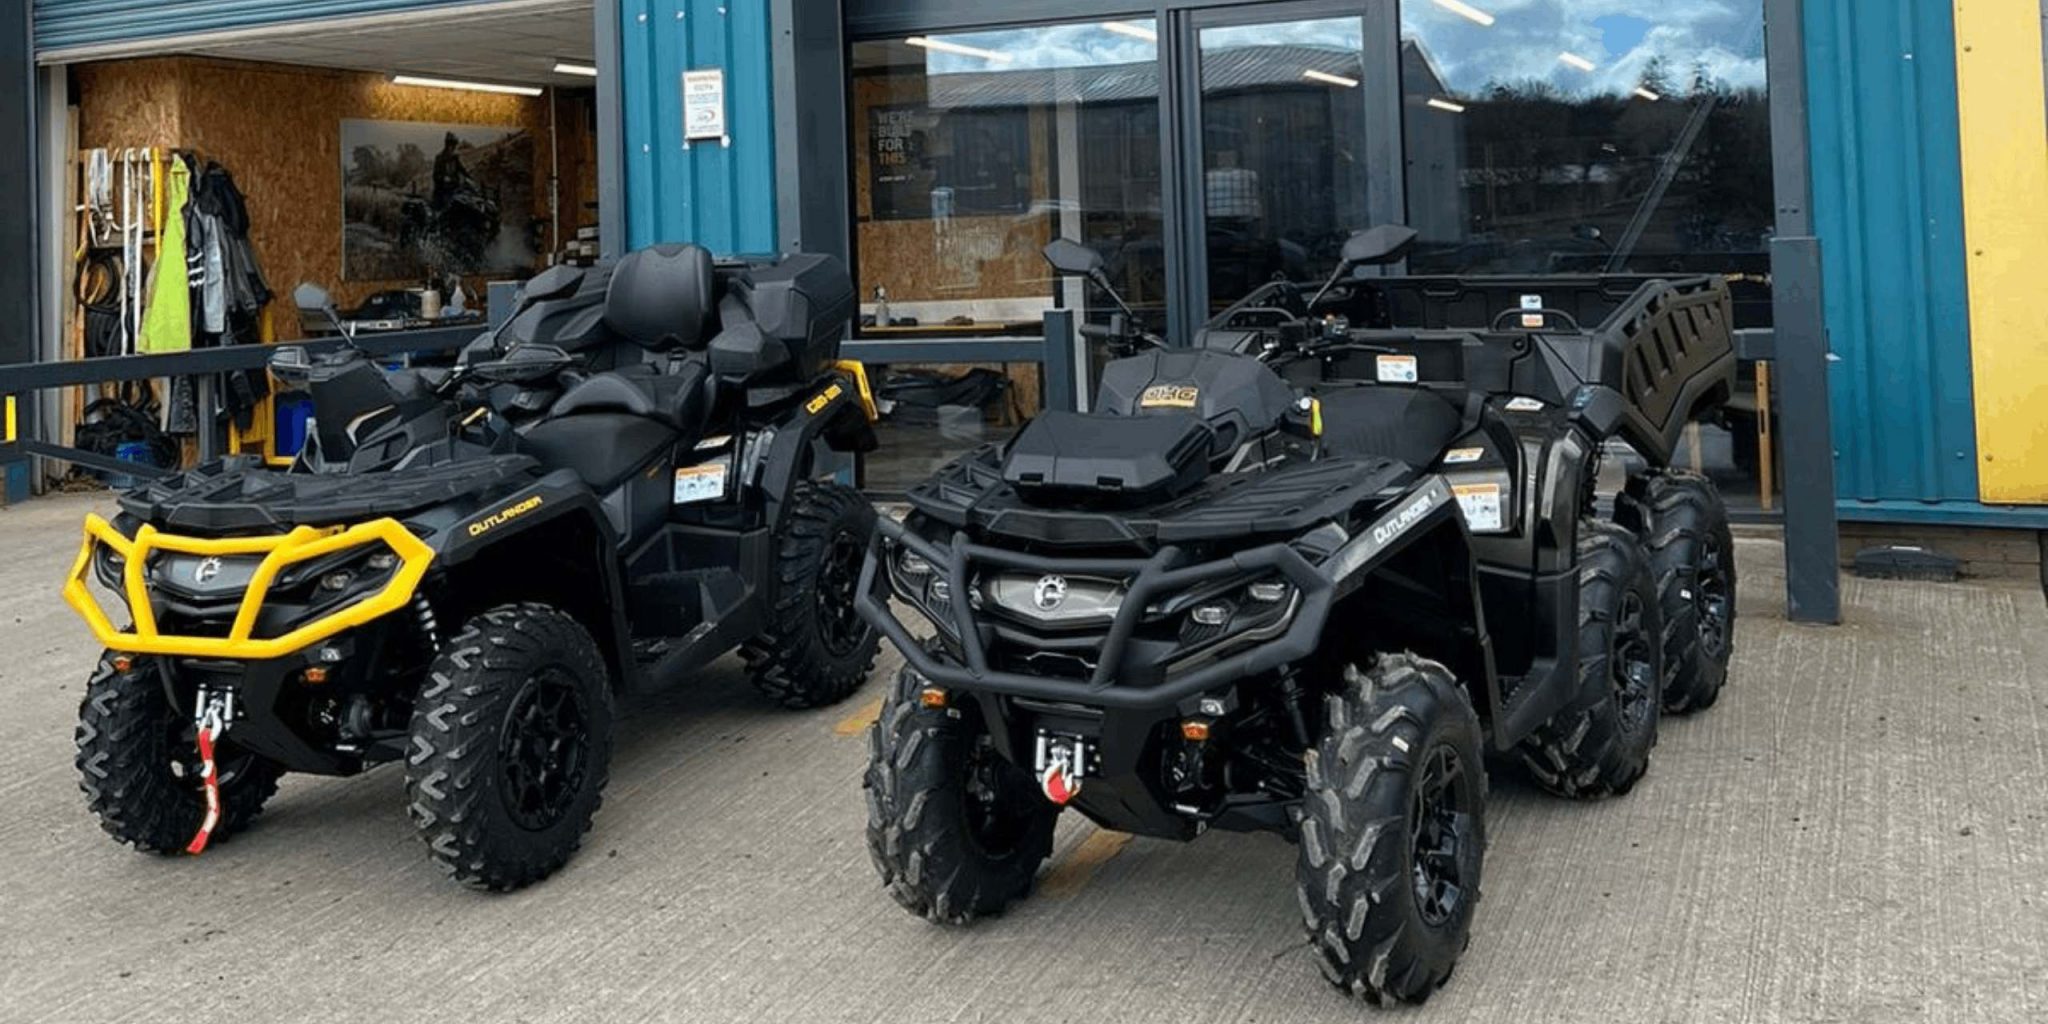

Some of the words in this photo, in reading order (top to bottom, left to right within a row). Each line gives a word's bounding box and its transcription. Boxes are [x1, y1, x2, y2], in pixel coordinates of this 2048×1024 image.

[878, 138, 904, 152] FOR
[879, 152, 907, 165] THIS
[468, 495, 543, 536] OUTLANDER
[1373, 487, 1433, 544] OUTLANDER
